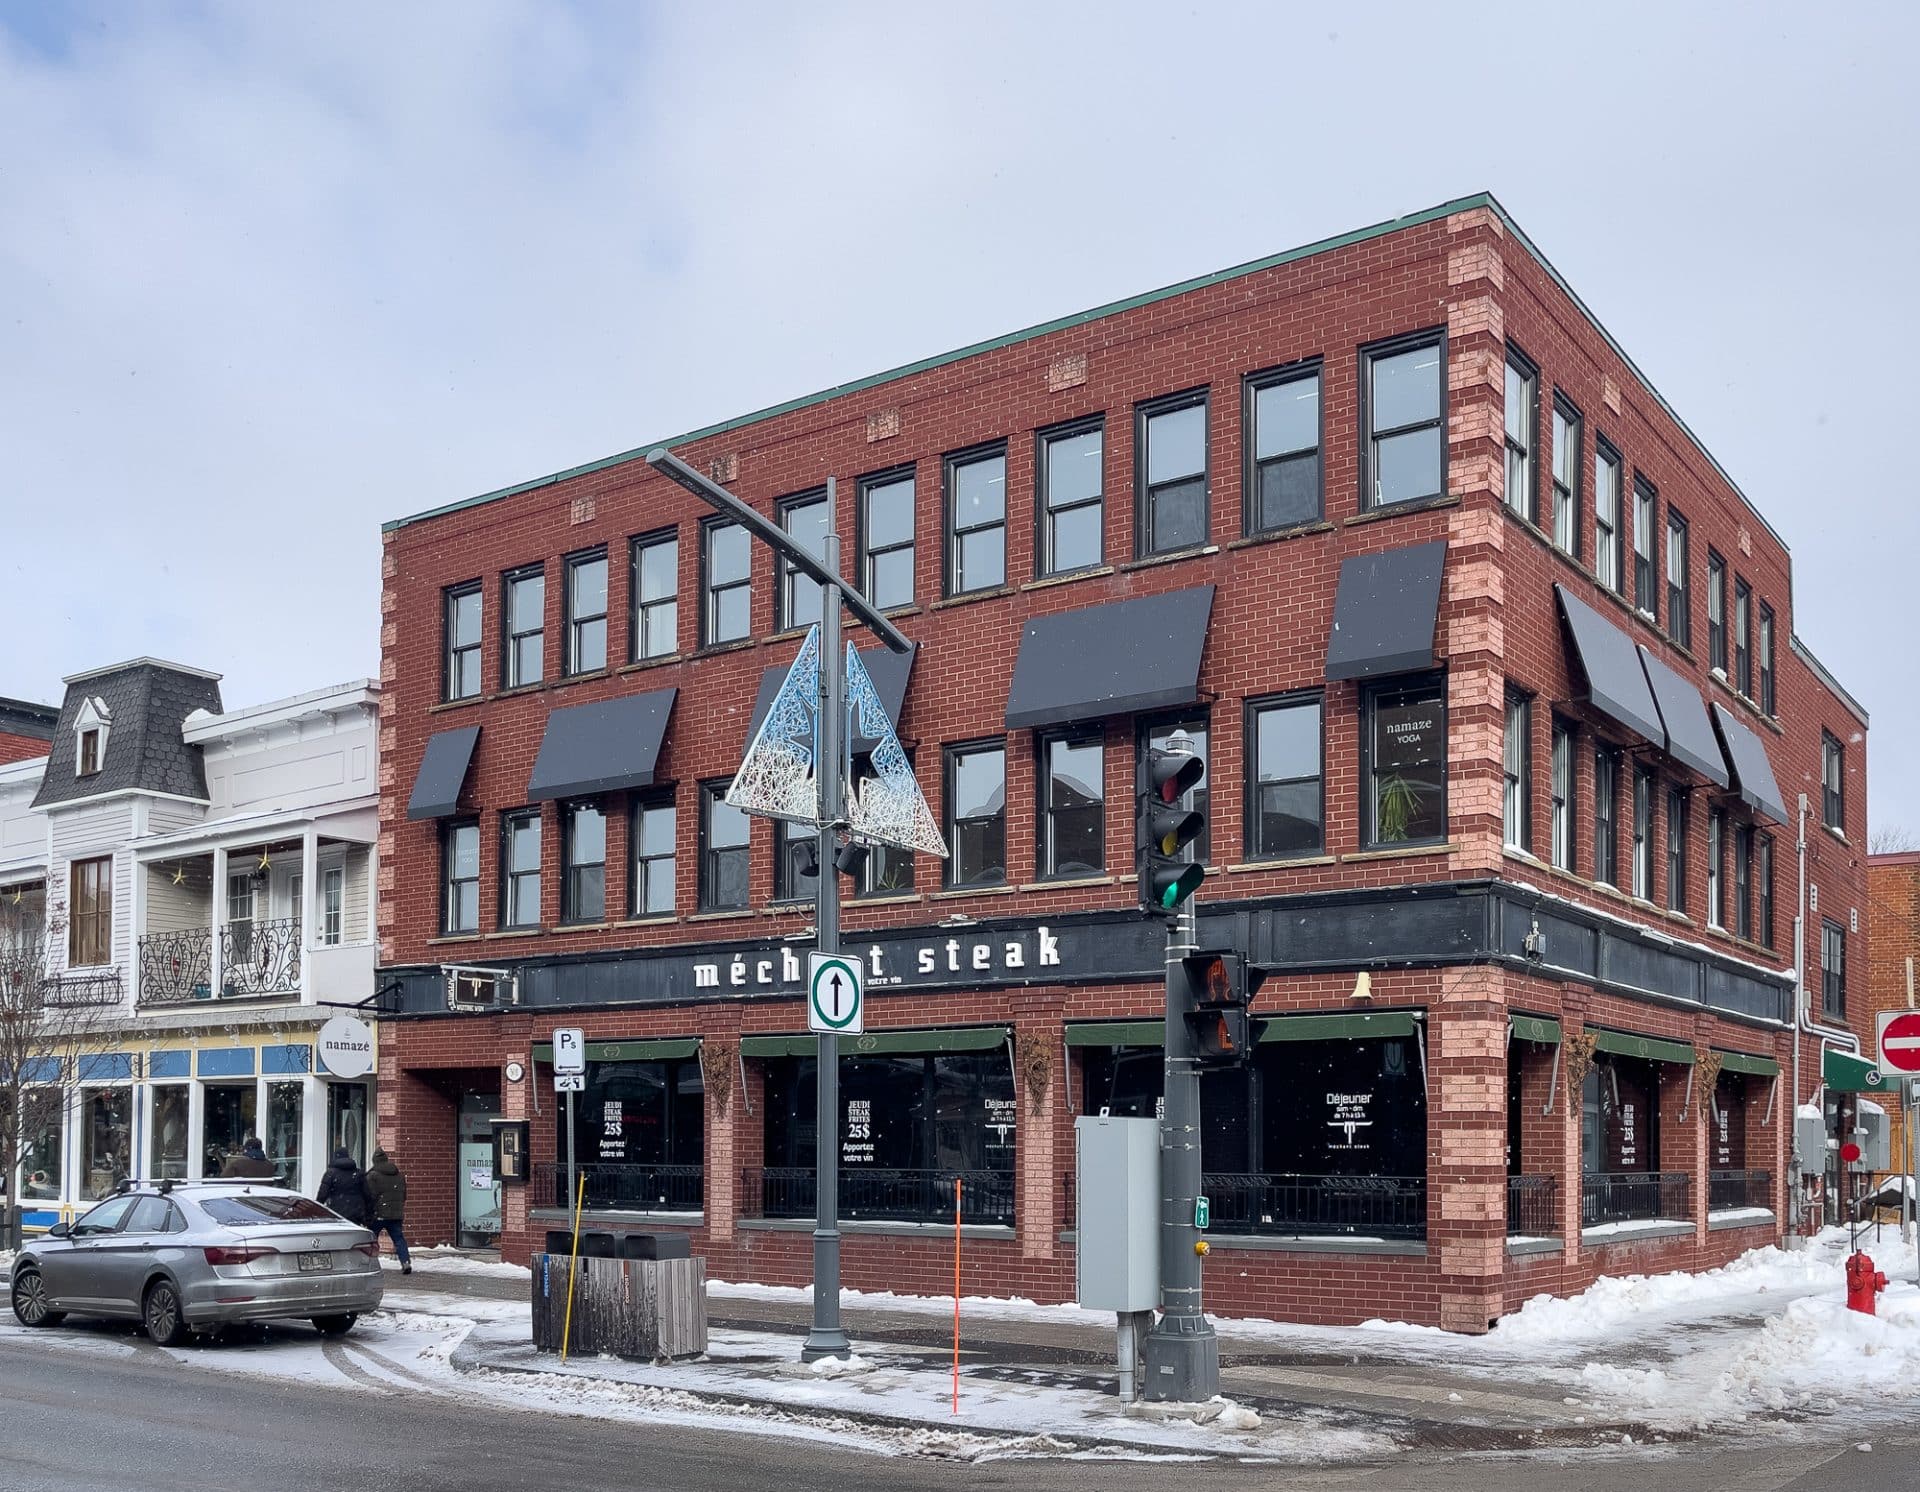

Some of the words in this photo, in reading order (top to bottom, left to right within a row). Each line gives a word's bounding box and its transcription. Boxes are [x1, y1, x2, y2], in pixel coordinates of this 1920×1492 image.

[1397, 734, 1421, 743] YOGA
[693, 945, 884, 987] mécht
[918, 926, 1061, 974] steak
[867, 977, 889, 985] votre
[890, 975, 902, 984] vin
[326, 1040, 370, 1052] namazé
[848, 1100, 870, 1108] JEUDI
[984, 1098, 1017, 1111] Déjeune
[1326, 1093, 1373, 1107] Déjeuner
[848, 1108, 870, 1116] STEAK
[604, 1121, 622, 1136] 25$
[848, 1123, 870, 1140] 25$
[600, 1139, 625, 1149] Apportez
[843, 1142, 874, 1153] Apportez
[843, 1154, 861, 1162] votre
[863, 1152, 873, 1162] vin
[467, 1159, 494, 1168] namaz
